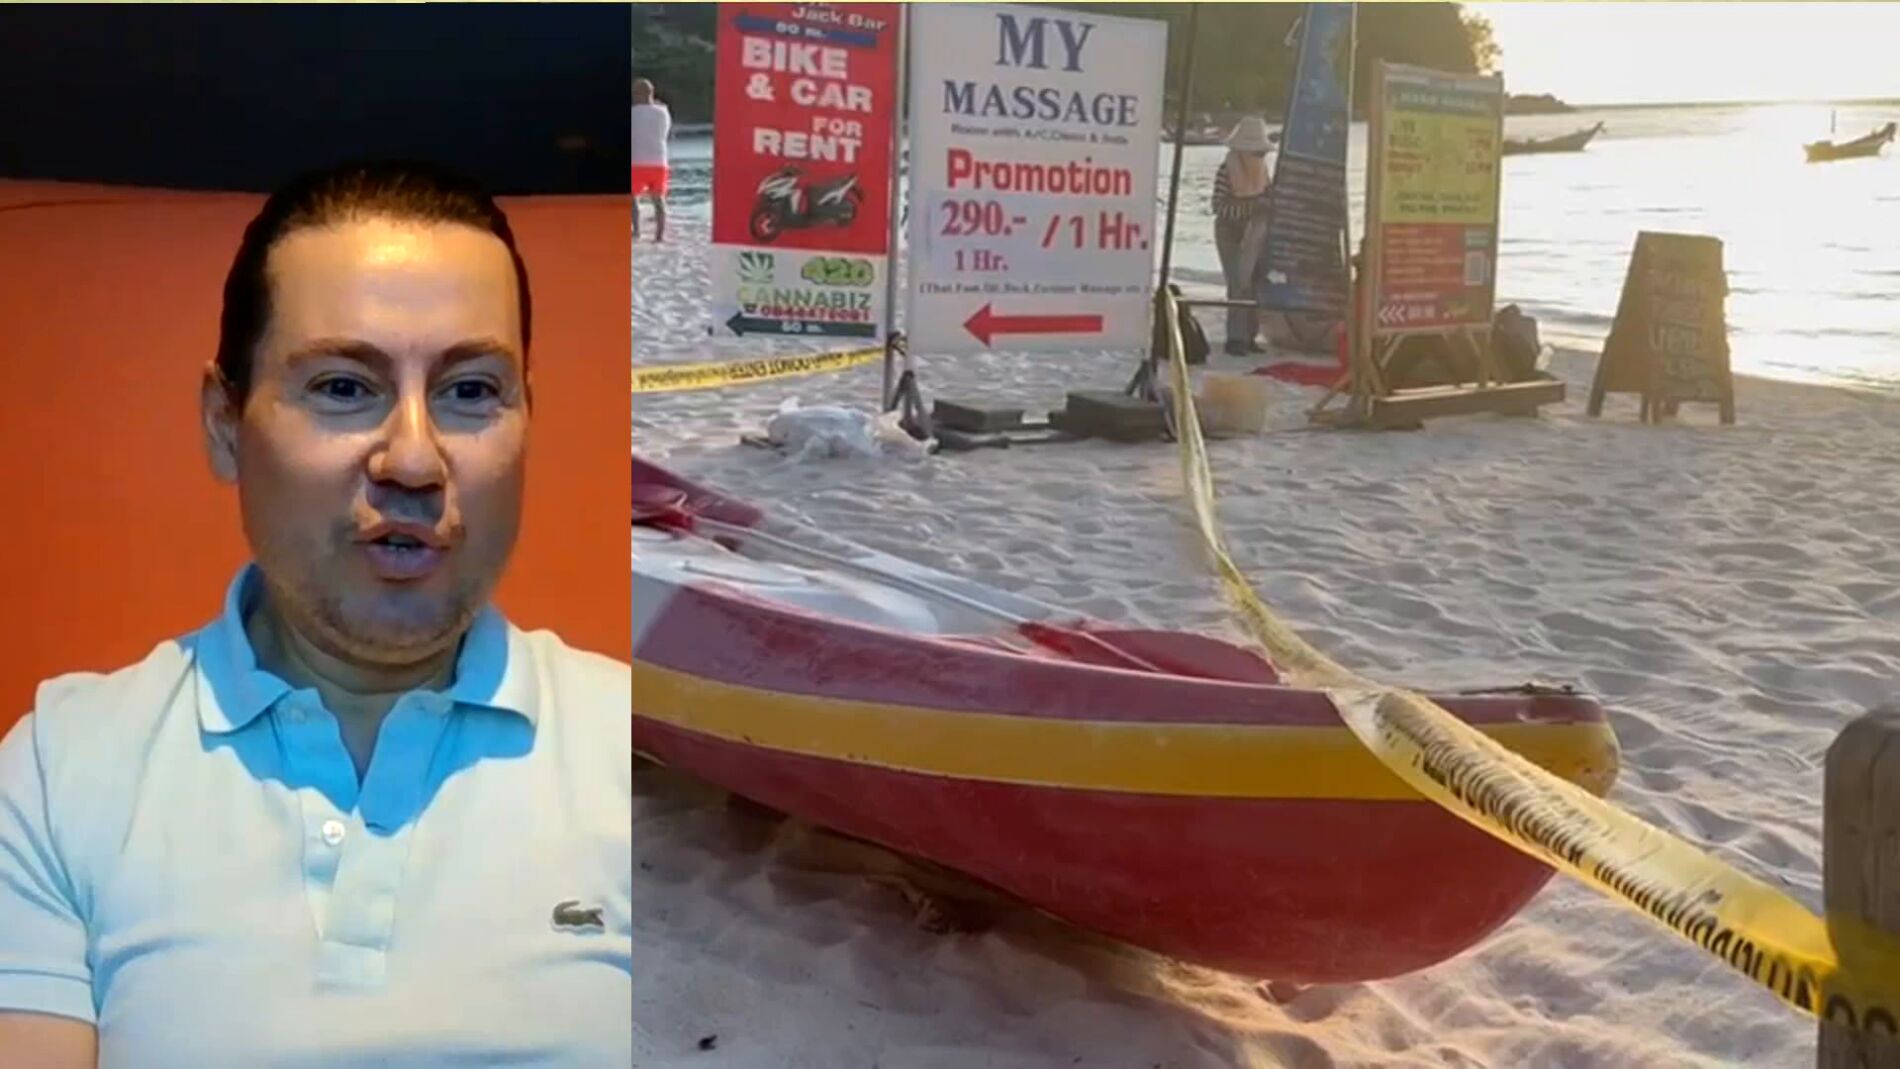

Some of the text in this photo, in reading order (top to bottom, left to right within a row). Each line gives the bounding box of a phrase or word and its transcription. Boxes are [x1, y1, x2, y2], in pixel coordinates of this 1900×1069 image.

[742, 36, 848, 80] BIKE
[994, 13, 1097, 73] MY
[745, 72, 873, 113] & CAR
[942, 79, 1140, 127] MASSAGE
[753, 127, 862, 163] RENT
[812, 116, 863, 138] FOR
[946, 148, 1132, 196] Promotion
[1099, 211, 1149, 250] Hr.
[955, 250, 1010, 272] 1 Hr.
[738, 285, 873, 310] CANNABIZ
